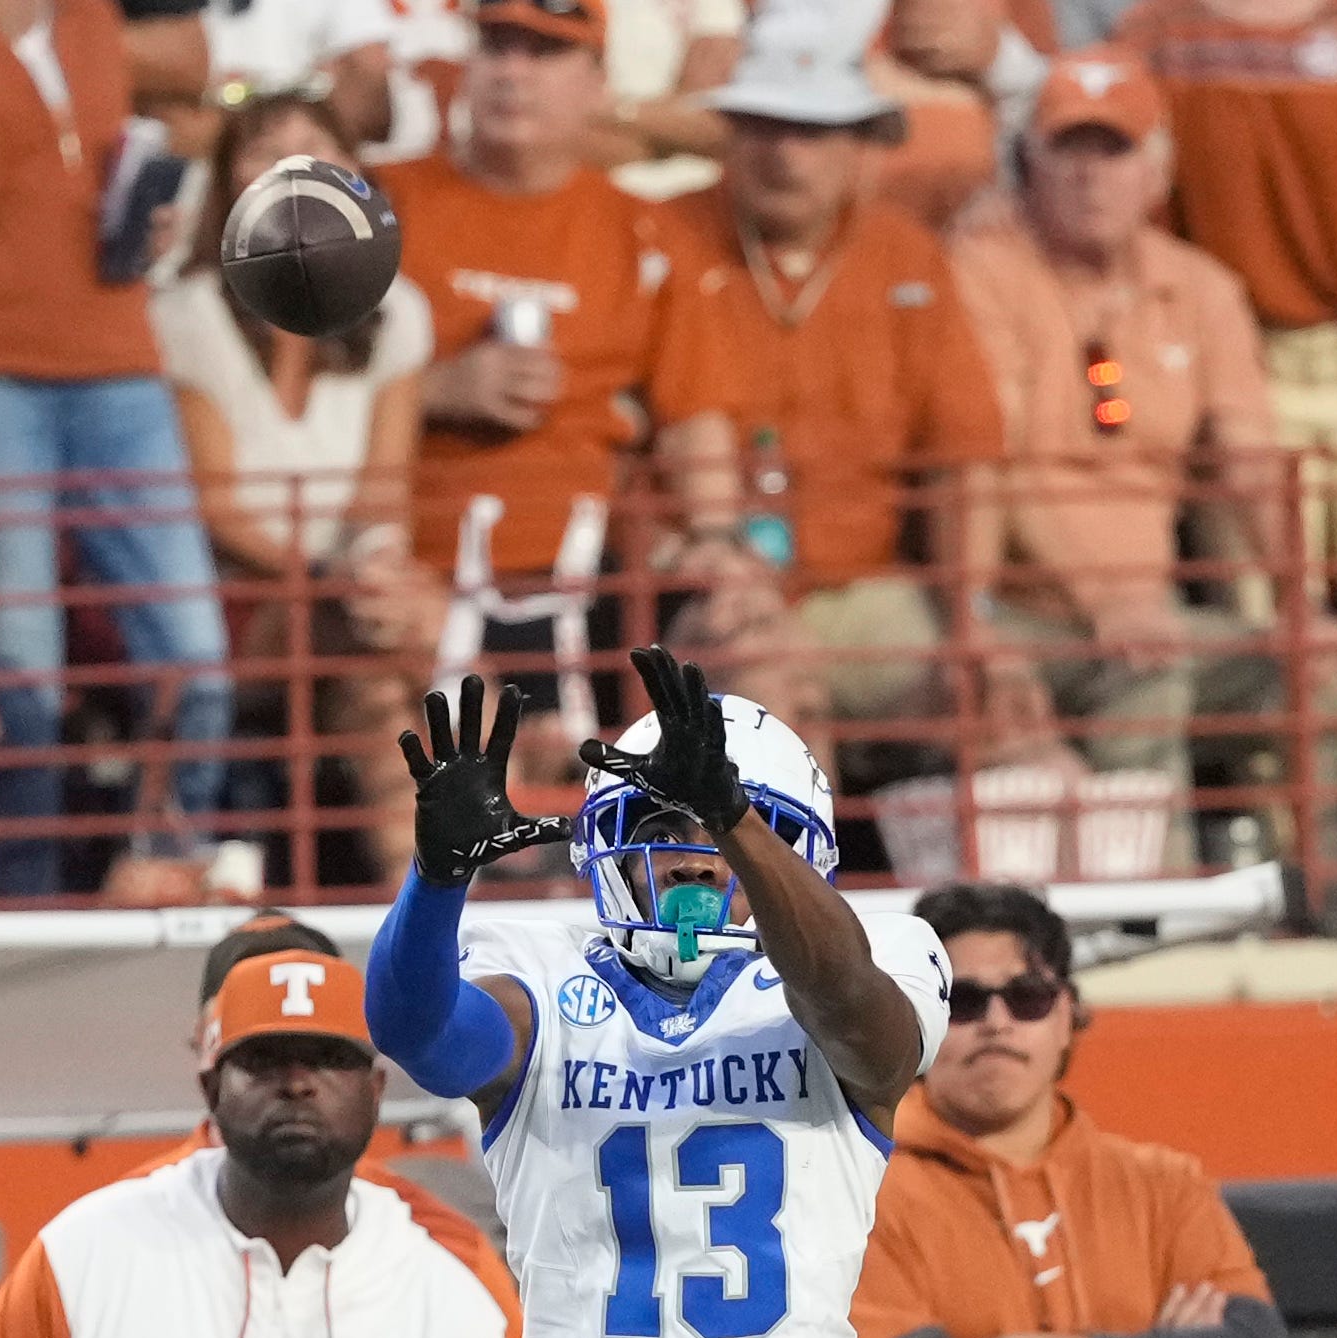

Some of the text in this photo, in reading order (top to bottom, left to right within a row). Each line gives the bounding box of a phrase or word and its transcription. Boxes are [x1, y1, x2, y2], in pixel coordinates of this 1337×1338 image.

[269, 962, 326, 1017] T
[563, 977, 613, 1024] SEC
[561, 1047, 809, 1111] KENTUCKY
